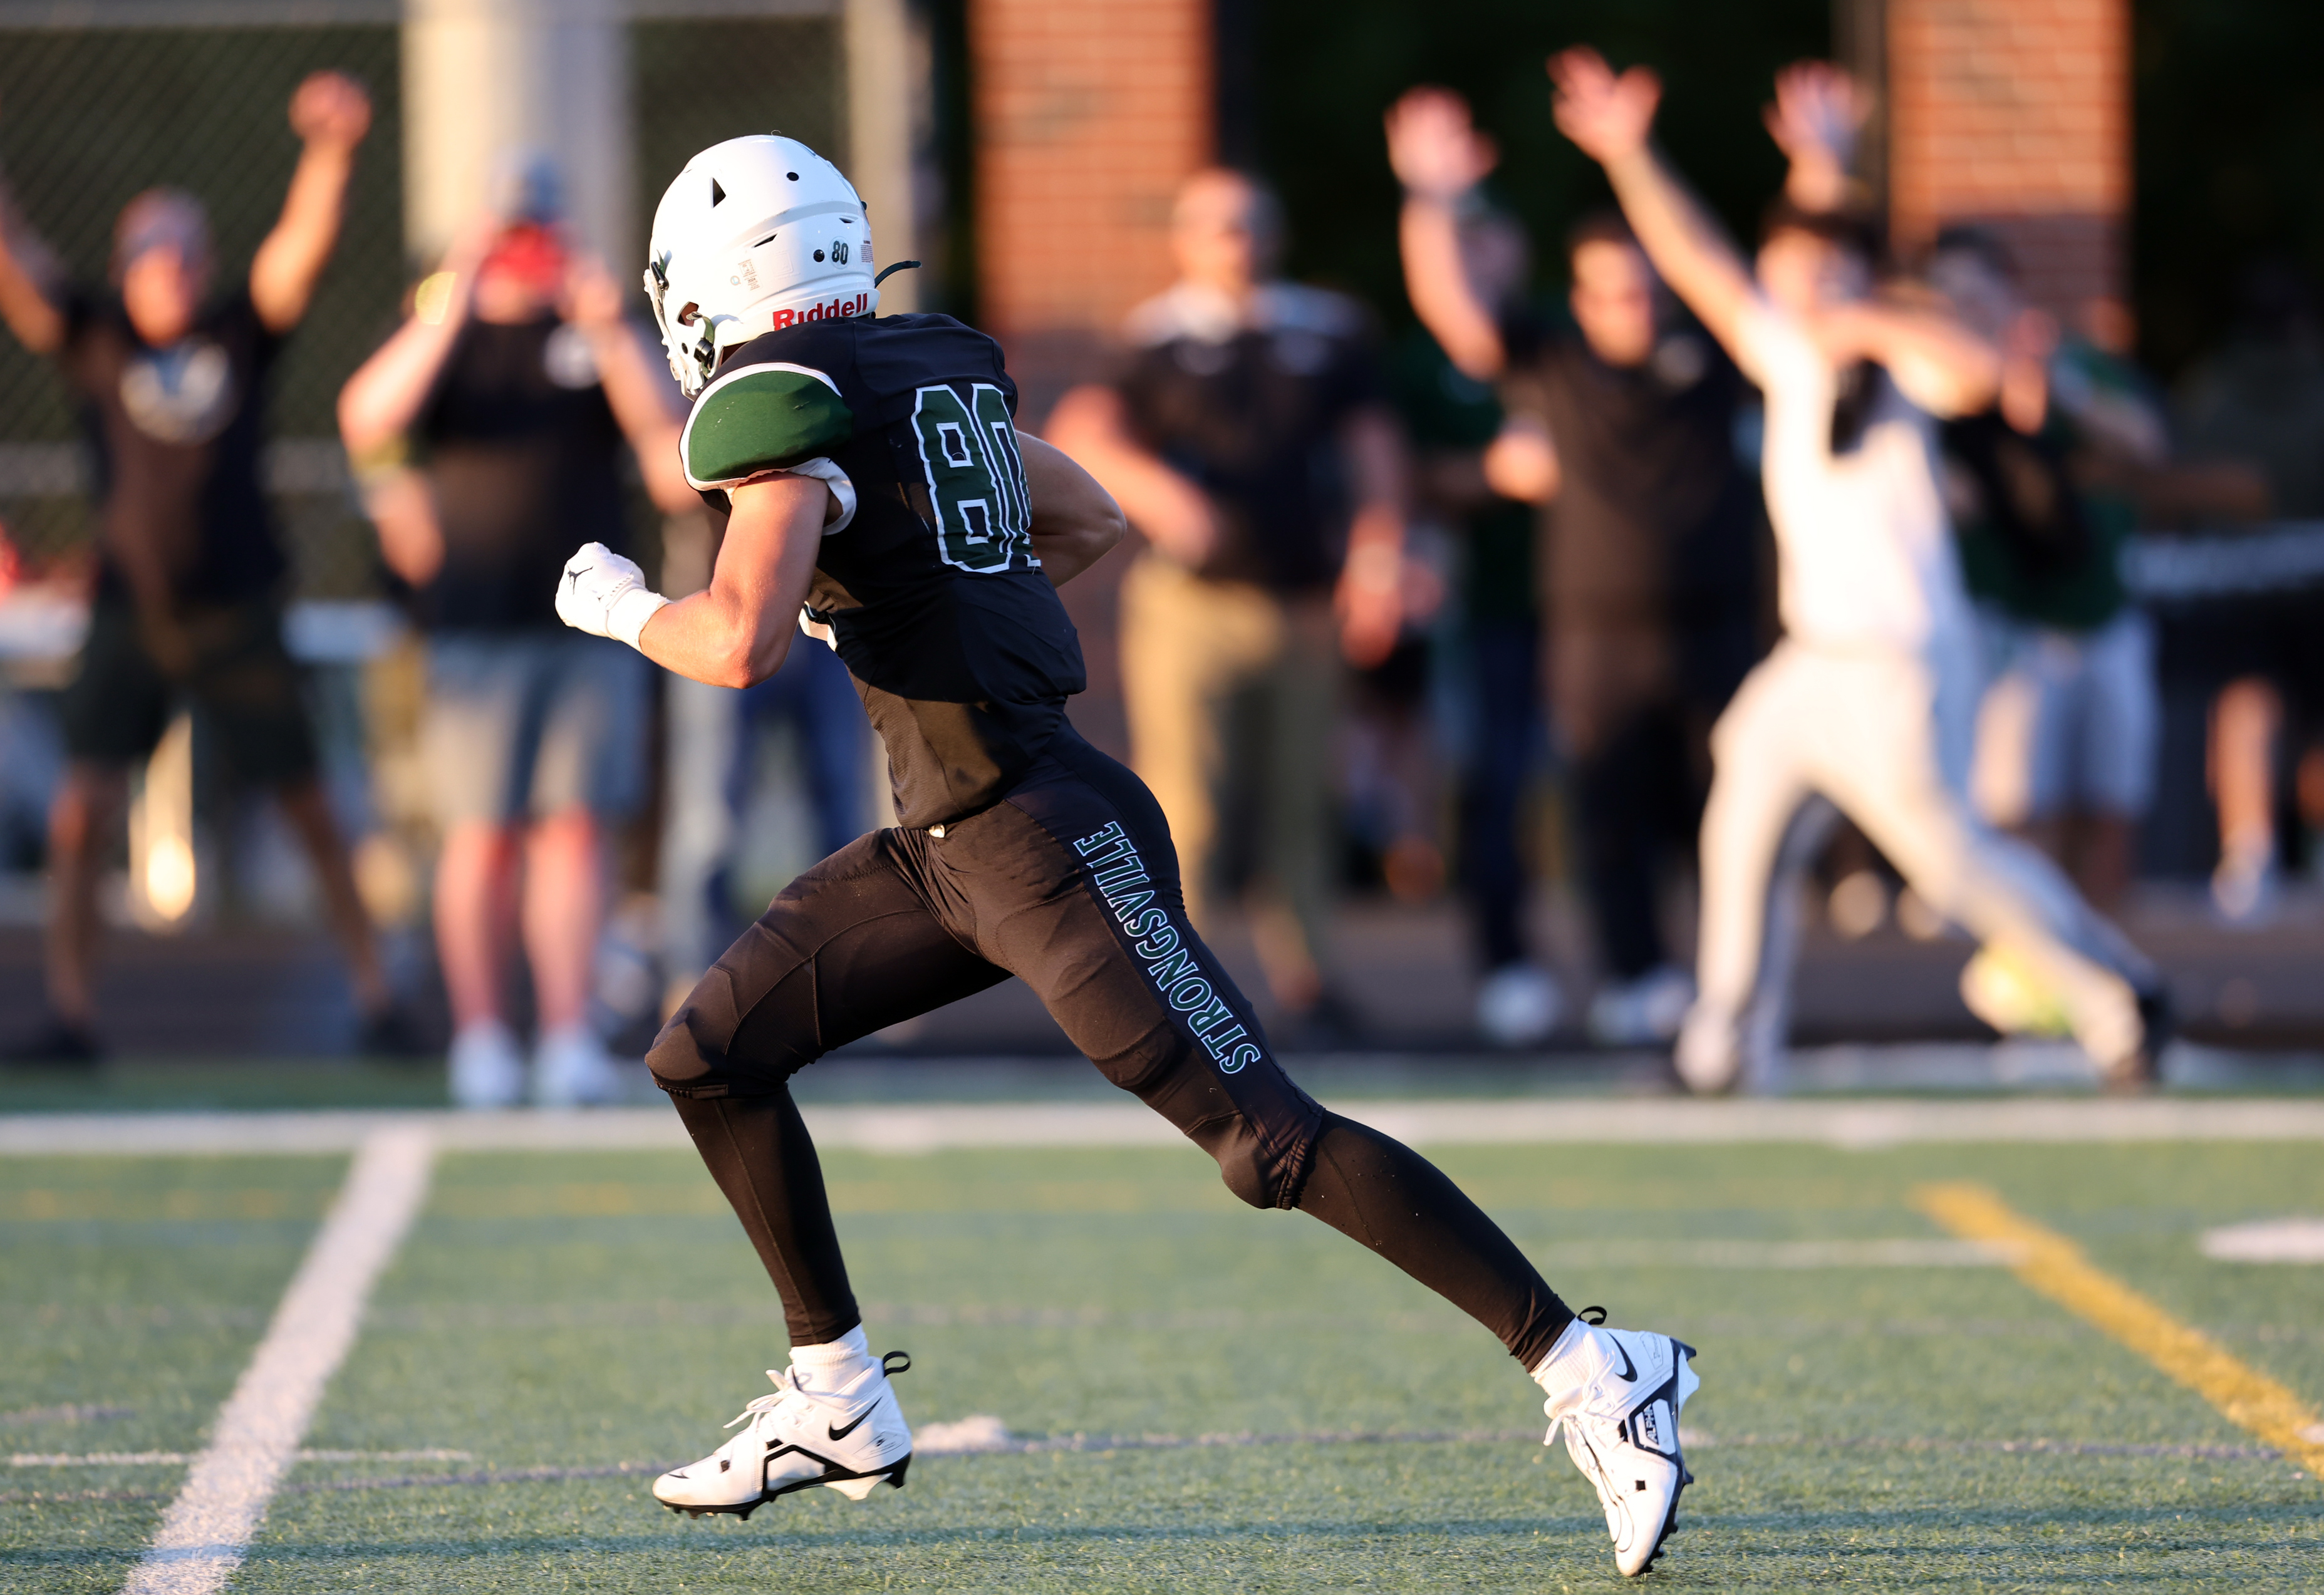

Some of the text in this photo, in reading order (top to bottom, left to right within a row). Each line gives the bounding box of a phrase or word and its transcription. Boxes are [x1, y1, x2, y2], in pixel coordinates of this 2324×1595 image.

[831, 240, 849, 265] 80
[772, 293, 868, 331] Riddell
[911, 383, 1041, 574] 80
[1072, 820, 1262, 1075] STRONGSVILLE
